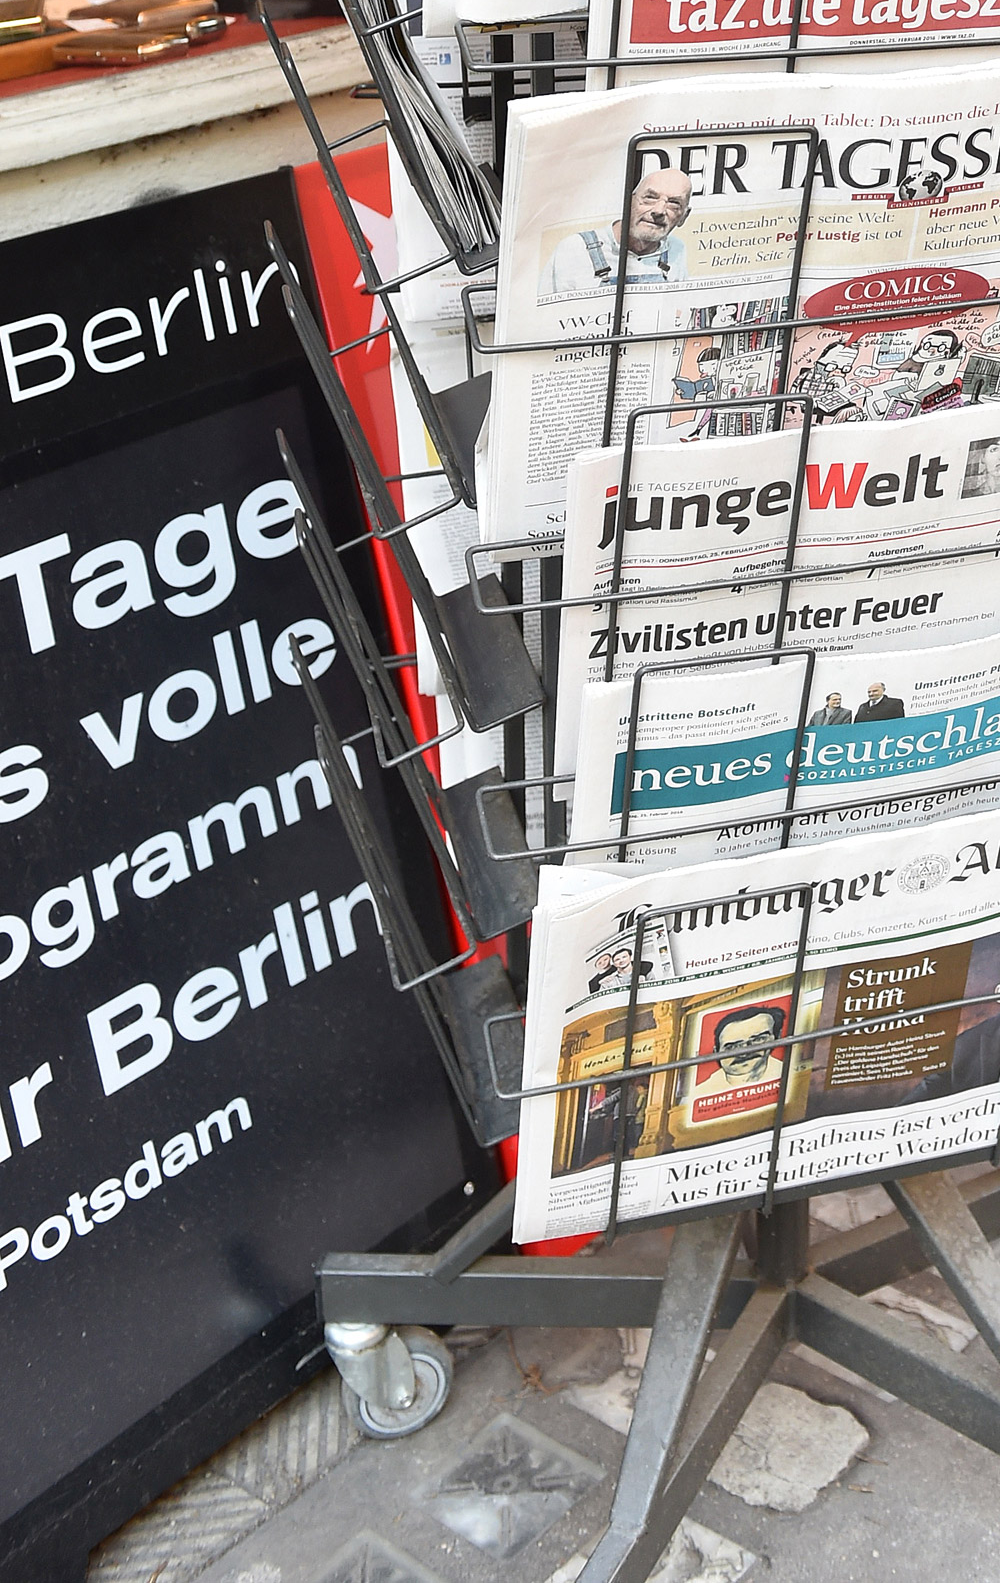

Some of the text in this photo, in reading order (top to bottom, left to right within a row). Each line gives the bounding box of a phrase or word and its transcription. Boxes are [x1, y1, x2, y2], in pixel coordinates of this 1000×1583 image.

[820, 113, 875, 128] Tablet:
[879, 114, 902, 128] Da
[903, 112, 963, 127] staunen
[966, 104, 991, 119] die
[787, 215, 814, 226] wr
[817, 212, 856, 225] seine
[856, 211, 896, 224] Welt:
[928, 201, 988, 218] Hermann
[697, 234, 773, 252] Moderator
[816, 229, 862, 243] Lustig
[864, 229, 882, 240] ist
[884, 229, 904, 240] tot
[926, 219, 956, 236] über
[958, 219, 989, 231] neue
[842, 270, 957, 304] COMICS
[0, 250, 304, 403] Berlin
[648, 475, 739, 493] TAGESZEITUNG
[0, 476, 314, 658] Tage
[755, 602, 847, 636] unter
[852, 589, 944, 628] Feuer
[913, 666, 988, 691] Umstrittener
[79, 614, 338, 774] volle
[630, 748, 773, 794] neues
[796, 754, 937, 782] SOZIALISTISCHE
[685, 940, 798, 969] Heute 12 Seiten extra
[846, 956, 938, 990] Strunk
[86, 878, 388, 1102] Berlin
[842, 986, 907, 1014] trifft
[698, 1080, 782, 1109] HEINZ STRUNK
[665, 1158, 739, 1186] Miete
[787, 1126, 886, 1159] Rathaus
[891, 1117, 934, 1139] fast
[660, 1185, 710, 1208] Aus
[714, 1174, 753, 1201] für
[756, 1148, 890, 1190] Stuttgarter
